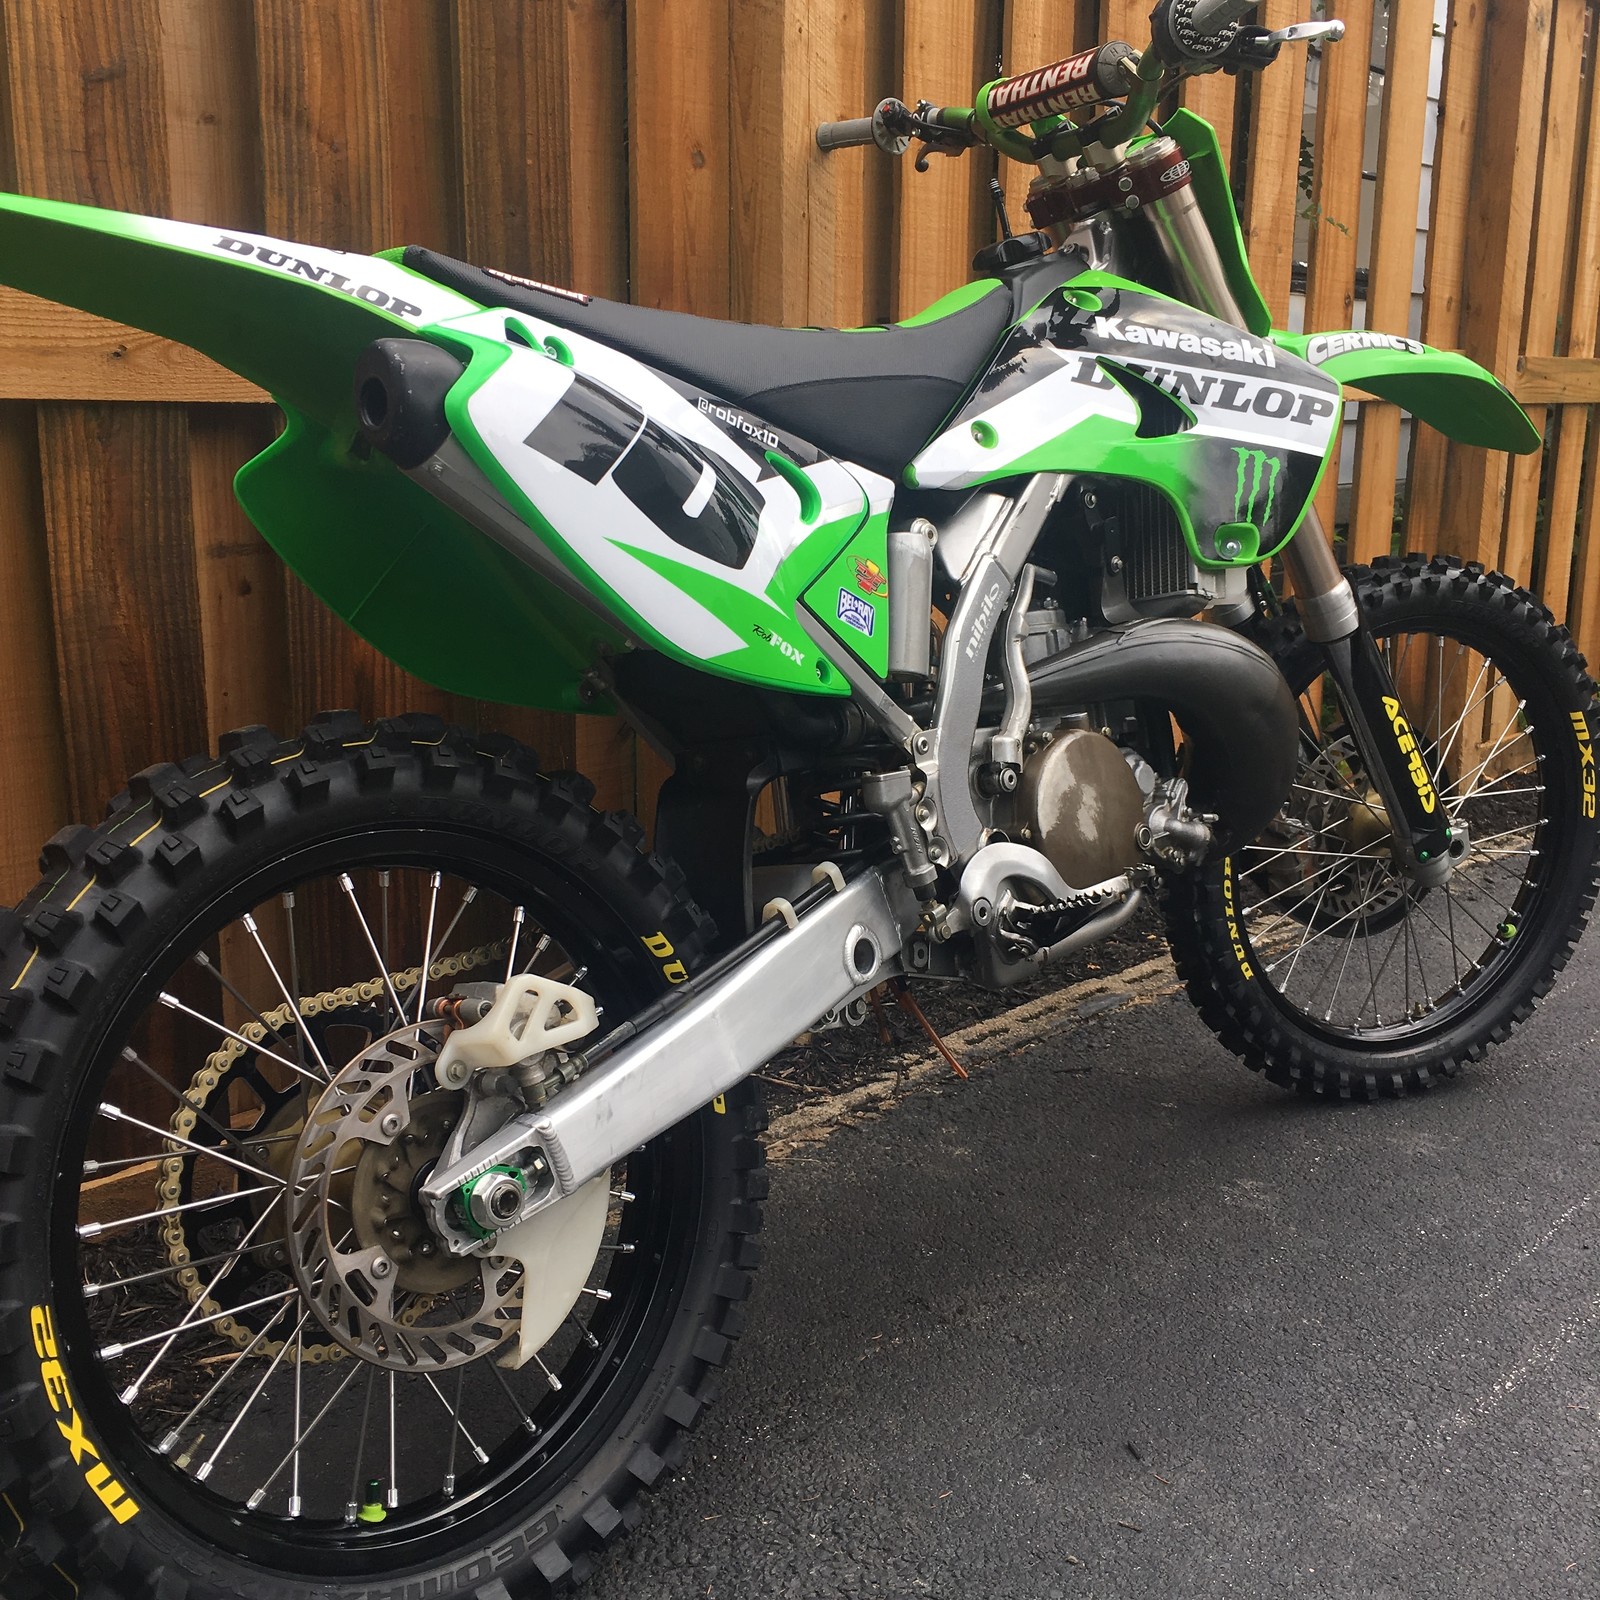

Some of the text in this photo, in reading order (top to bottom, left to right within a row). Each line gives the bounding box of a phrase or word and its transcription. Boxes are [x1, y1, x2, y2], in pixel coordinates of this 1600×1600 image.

[213, 235, 422, 318] DUNLOP
[1095, 316, 1277, 368] Kawasaki
[697, 396, 779, 449] @robfox10
[752, 624, 806, 666] Rob FOX
[965, 583, 1000, 658] nihilo
[1569, 711, 1596, 819] MX32
[1223, 856, 1255, 981] DUNLOP
[30, 1305, 140, 1525] MX32
